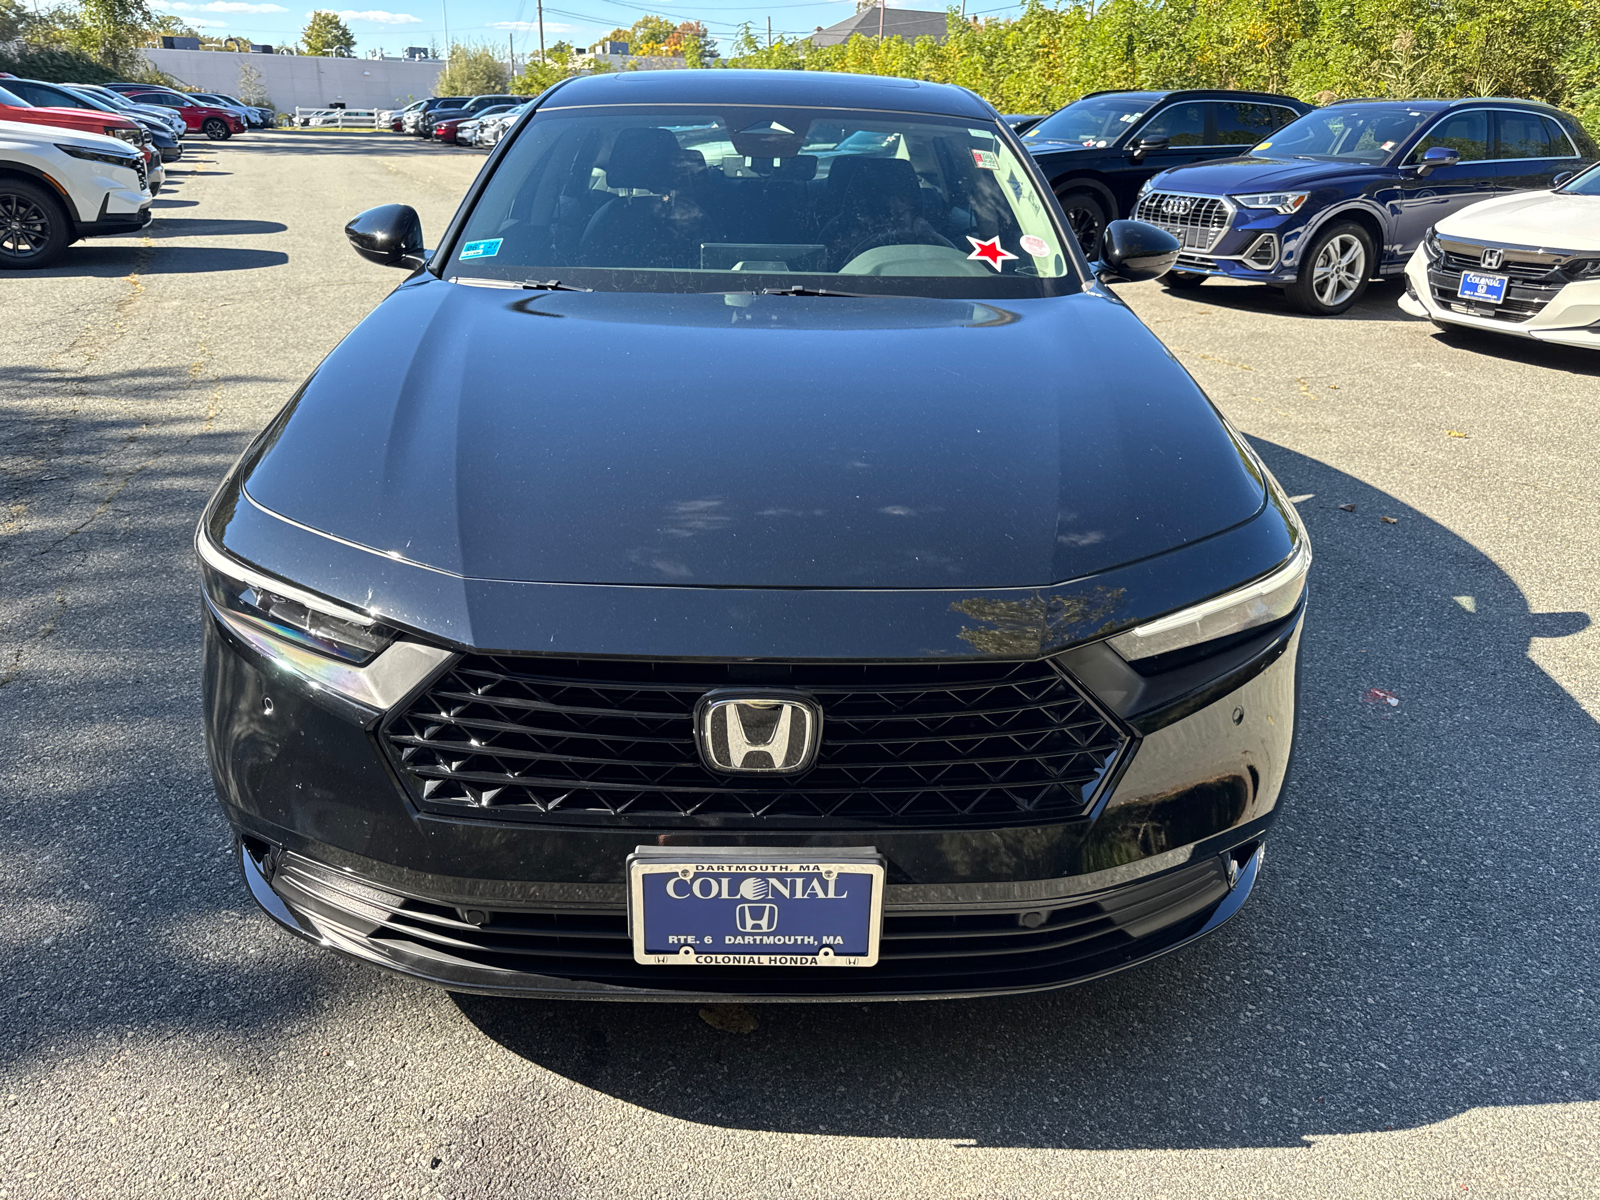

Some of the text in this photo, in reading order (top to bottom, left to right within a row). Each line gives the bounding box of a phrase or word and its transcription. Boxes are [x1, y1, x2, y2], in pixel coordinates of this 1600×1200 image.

[1467, 273, 1501, 287] COLONIAL
[695, 864, 821, 872] DARTMOUTH, MA
[666, 876, 848, 900] COLONIAL
[668, 935, 844, 946] RTE. 6 DARTMOUTH, MA
[695, 955, 818, 965] COLONIAL HONDA
